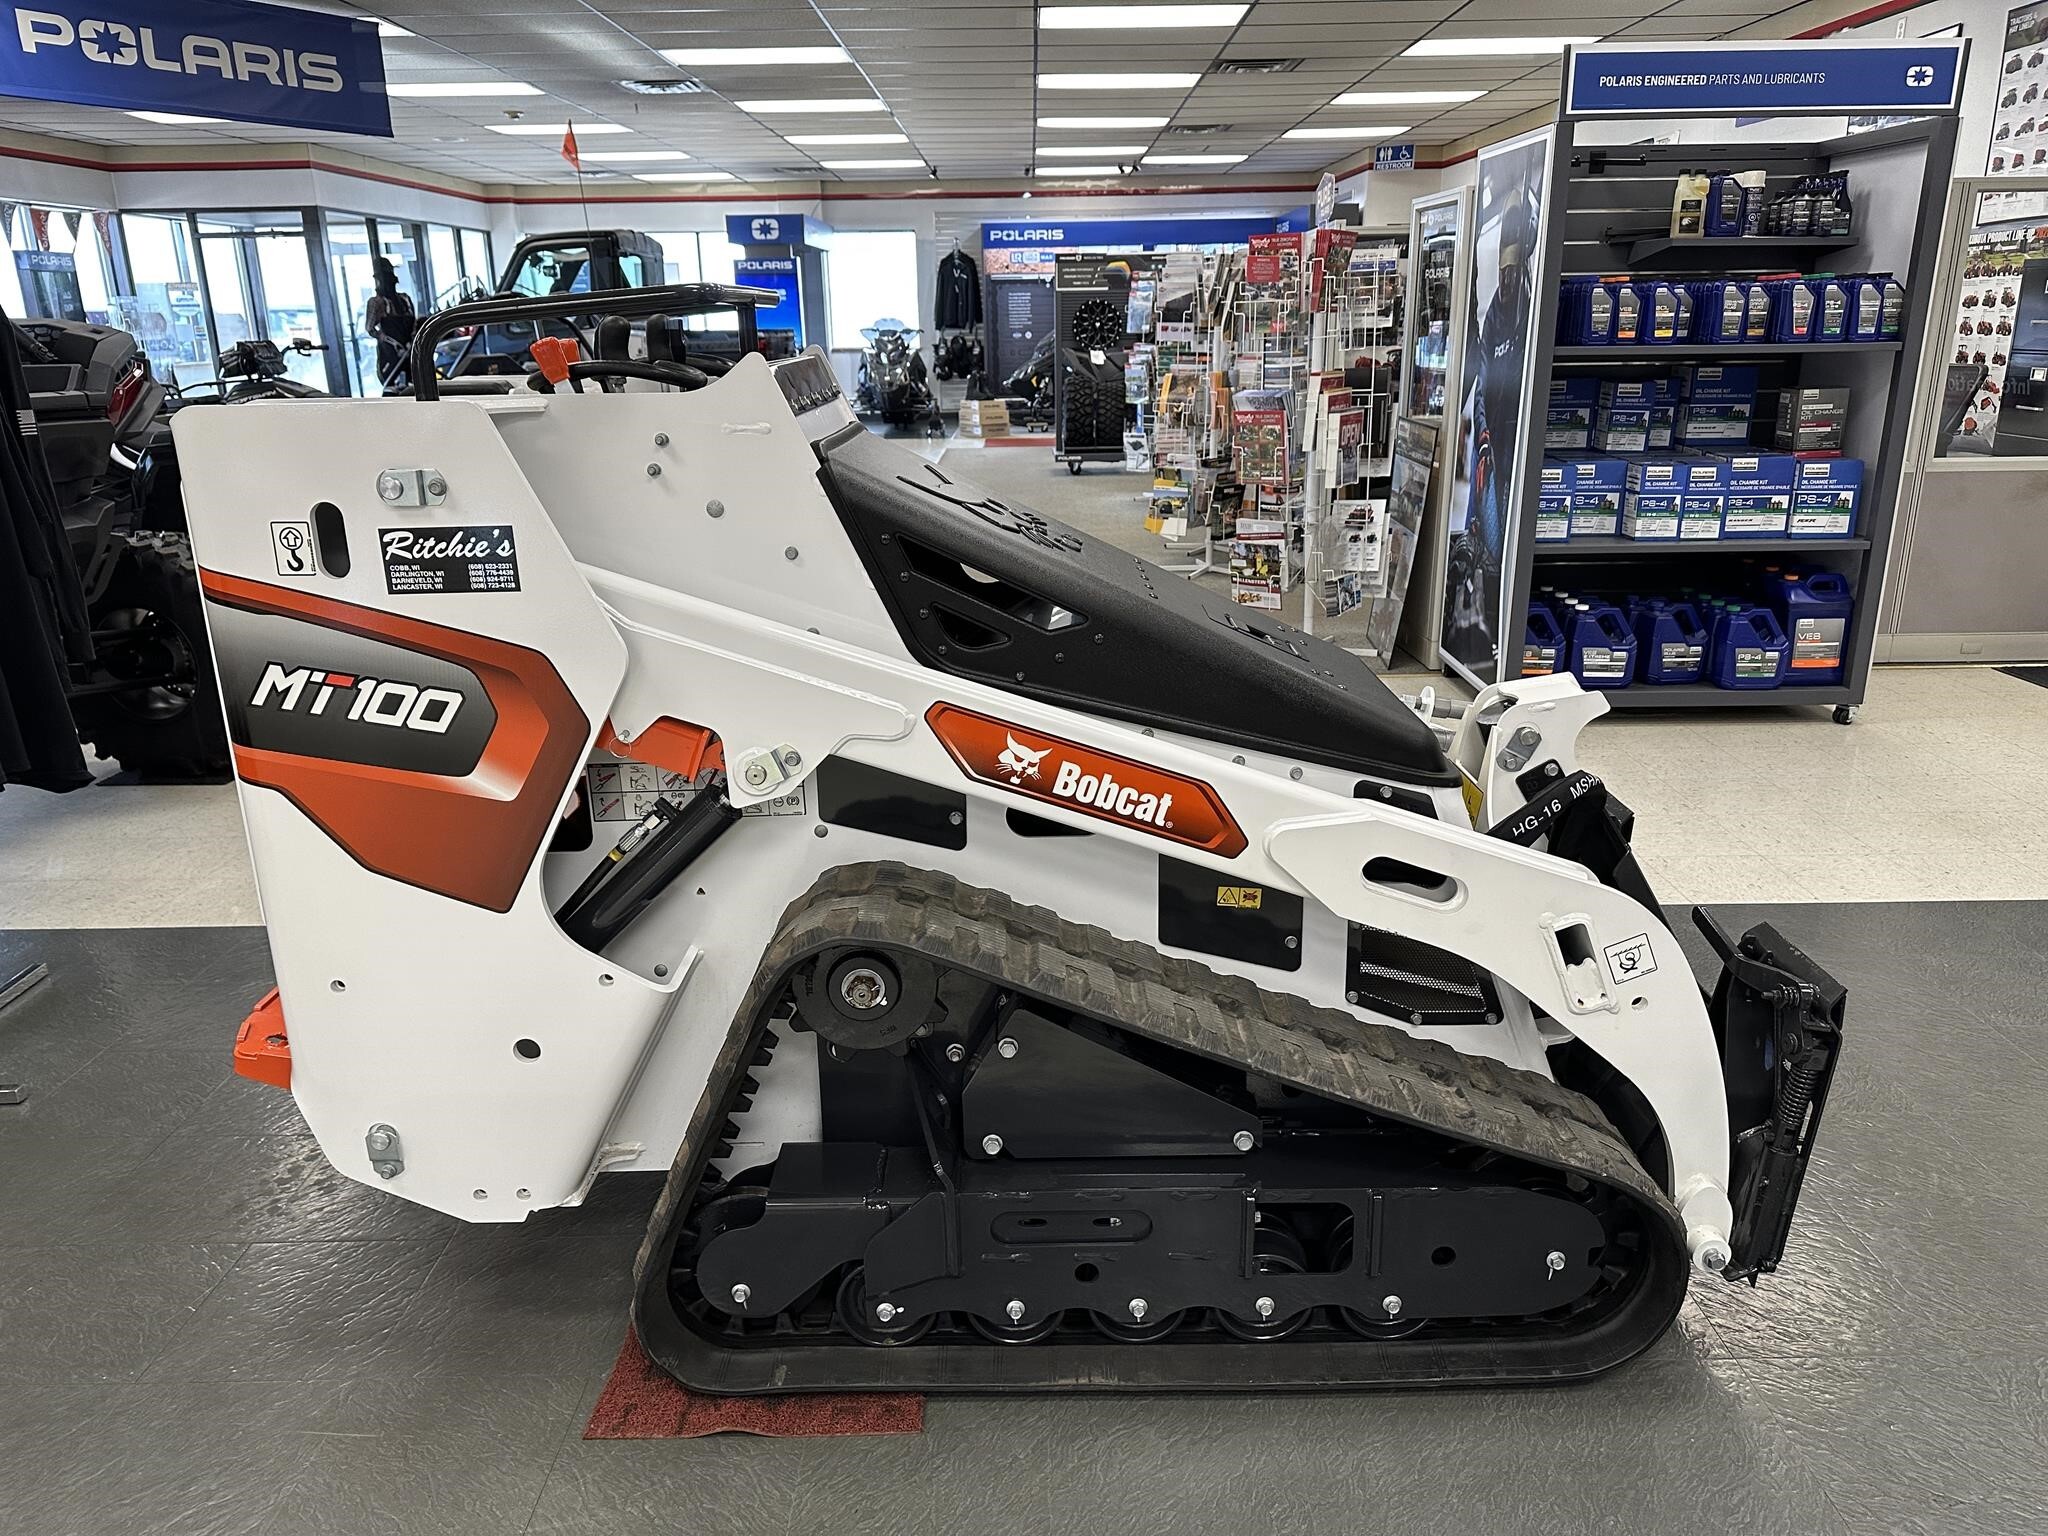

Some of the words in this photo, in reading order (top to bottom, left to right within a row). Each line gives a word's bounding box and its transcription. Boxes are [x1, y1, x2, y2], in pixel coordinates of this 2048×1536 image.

[15, 8, 344, 93] POLARIS
[1600, 75, 1642, 87] POLARIS
[1645, 74, 1707, 86] ENGINEERED
[1709, 73, 1740, 85] PARTS
[1742, 73, 1762, 84] AND
[1764, 72, 1825, 84] LUBRICANTS
[1376, 162, 1412, 170] RESTROOM
[990, 229, 1064, 241] POLARIS
[31, 254, 72, 267] POLARIS
[738, 260, 793, 270] POLARIS
[1425, 267, 1450, 279] POLARIS
[1341, 423, 1361, 447] OPEN
[1797, 495, 1831, 504] PS-4
[382, 529, 514, 560] Ritchie's
[250, 664, 464, 734] MT100
[1052, 760, 1172, 827] Bobcat
[1512, 799, 1562, 837] HG-16
